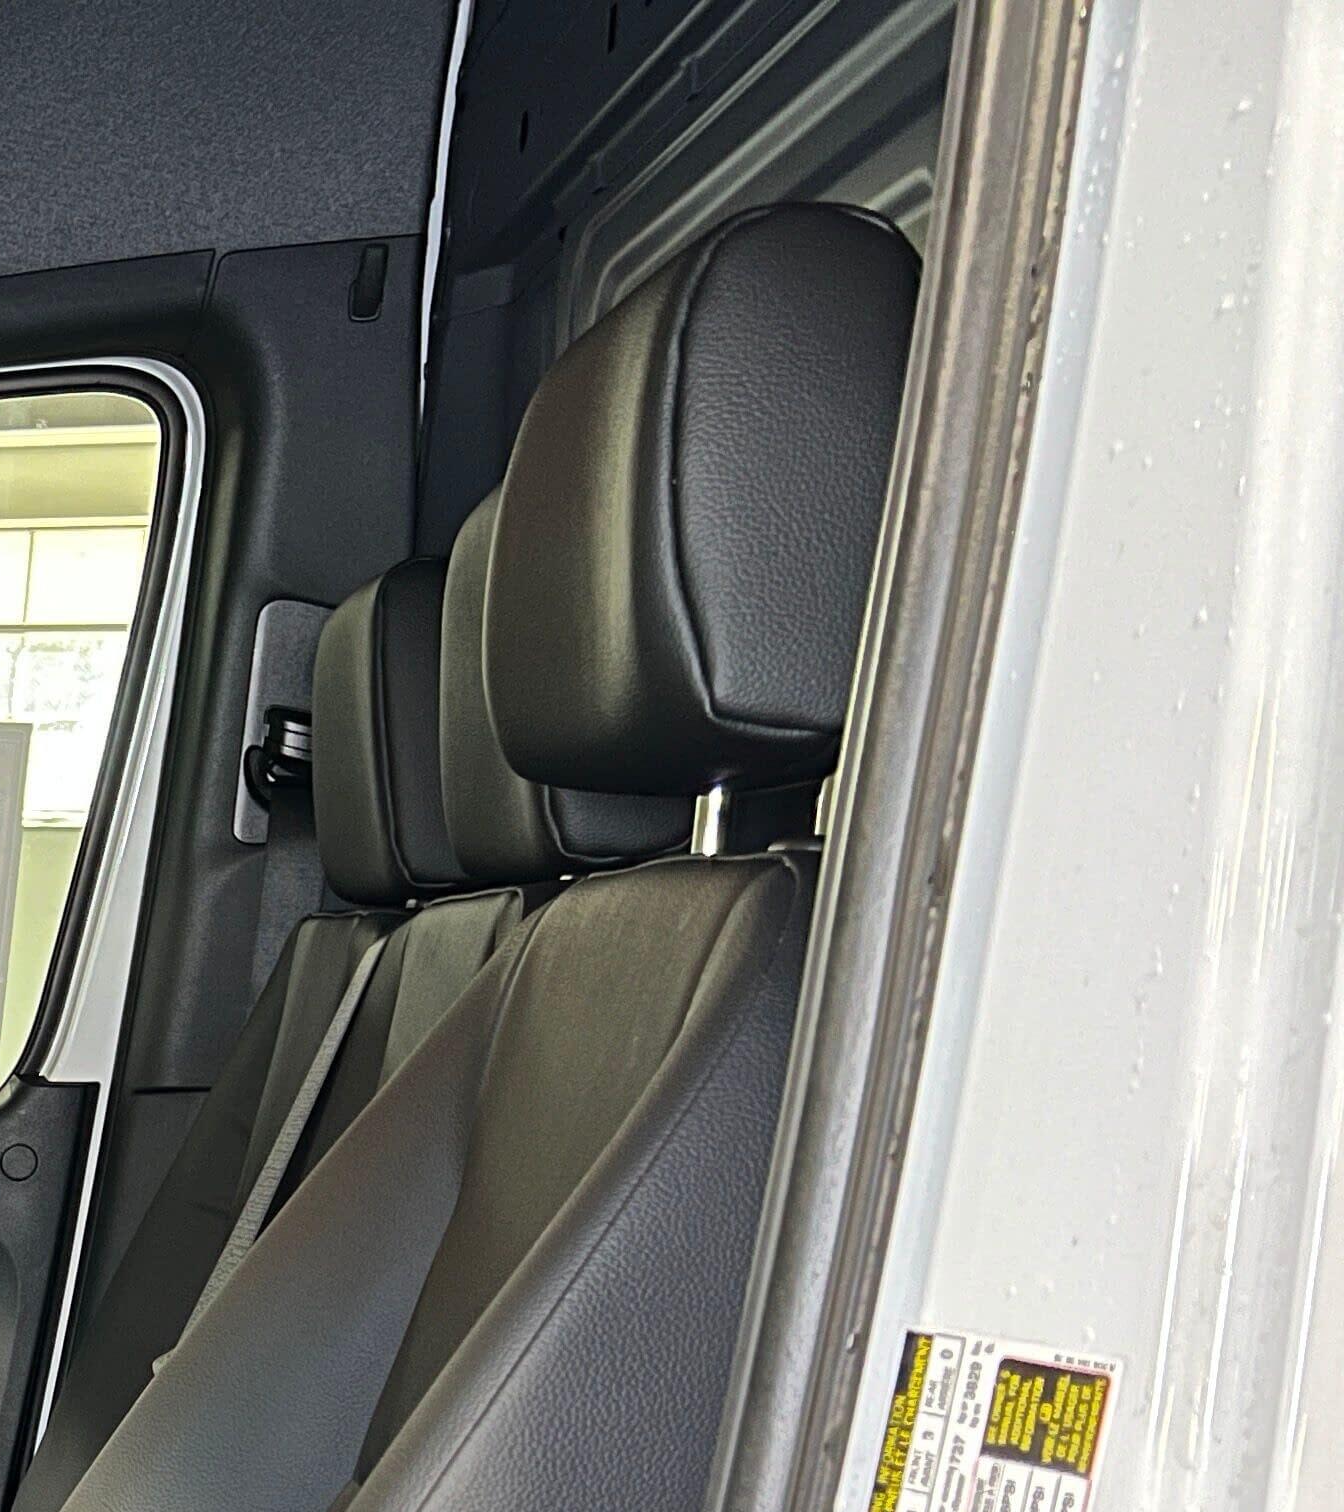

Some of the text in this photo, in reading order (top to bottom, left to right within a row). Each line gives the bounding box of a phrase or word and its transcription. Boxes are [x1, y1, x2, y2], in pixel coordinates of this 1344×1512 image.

[900, 1336, 933, 1426] CHARGEMENT
[938, 1347, 954, 1360] 0
[876, 1393, 907, 1484] INFORMATION
